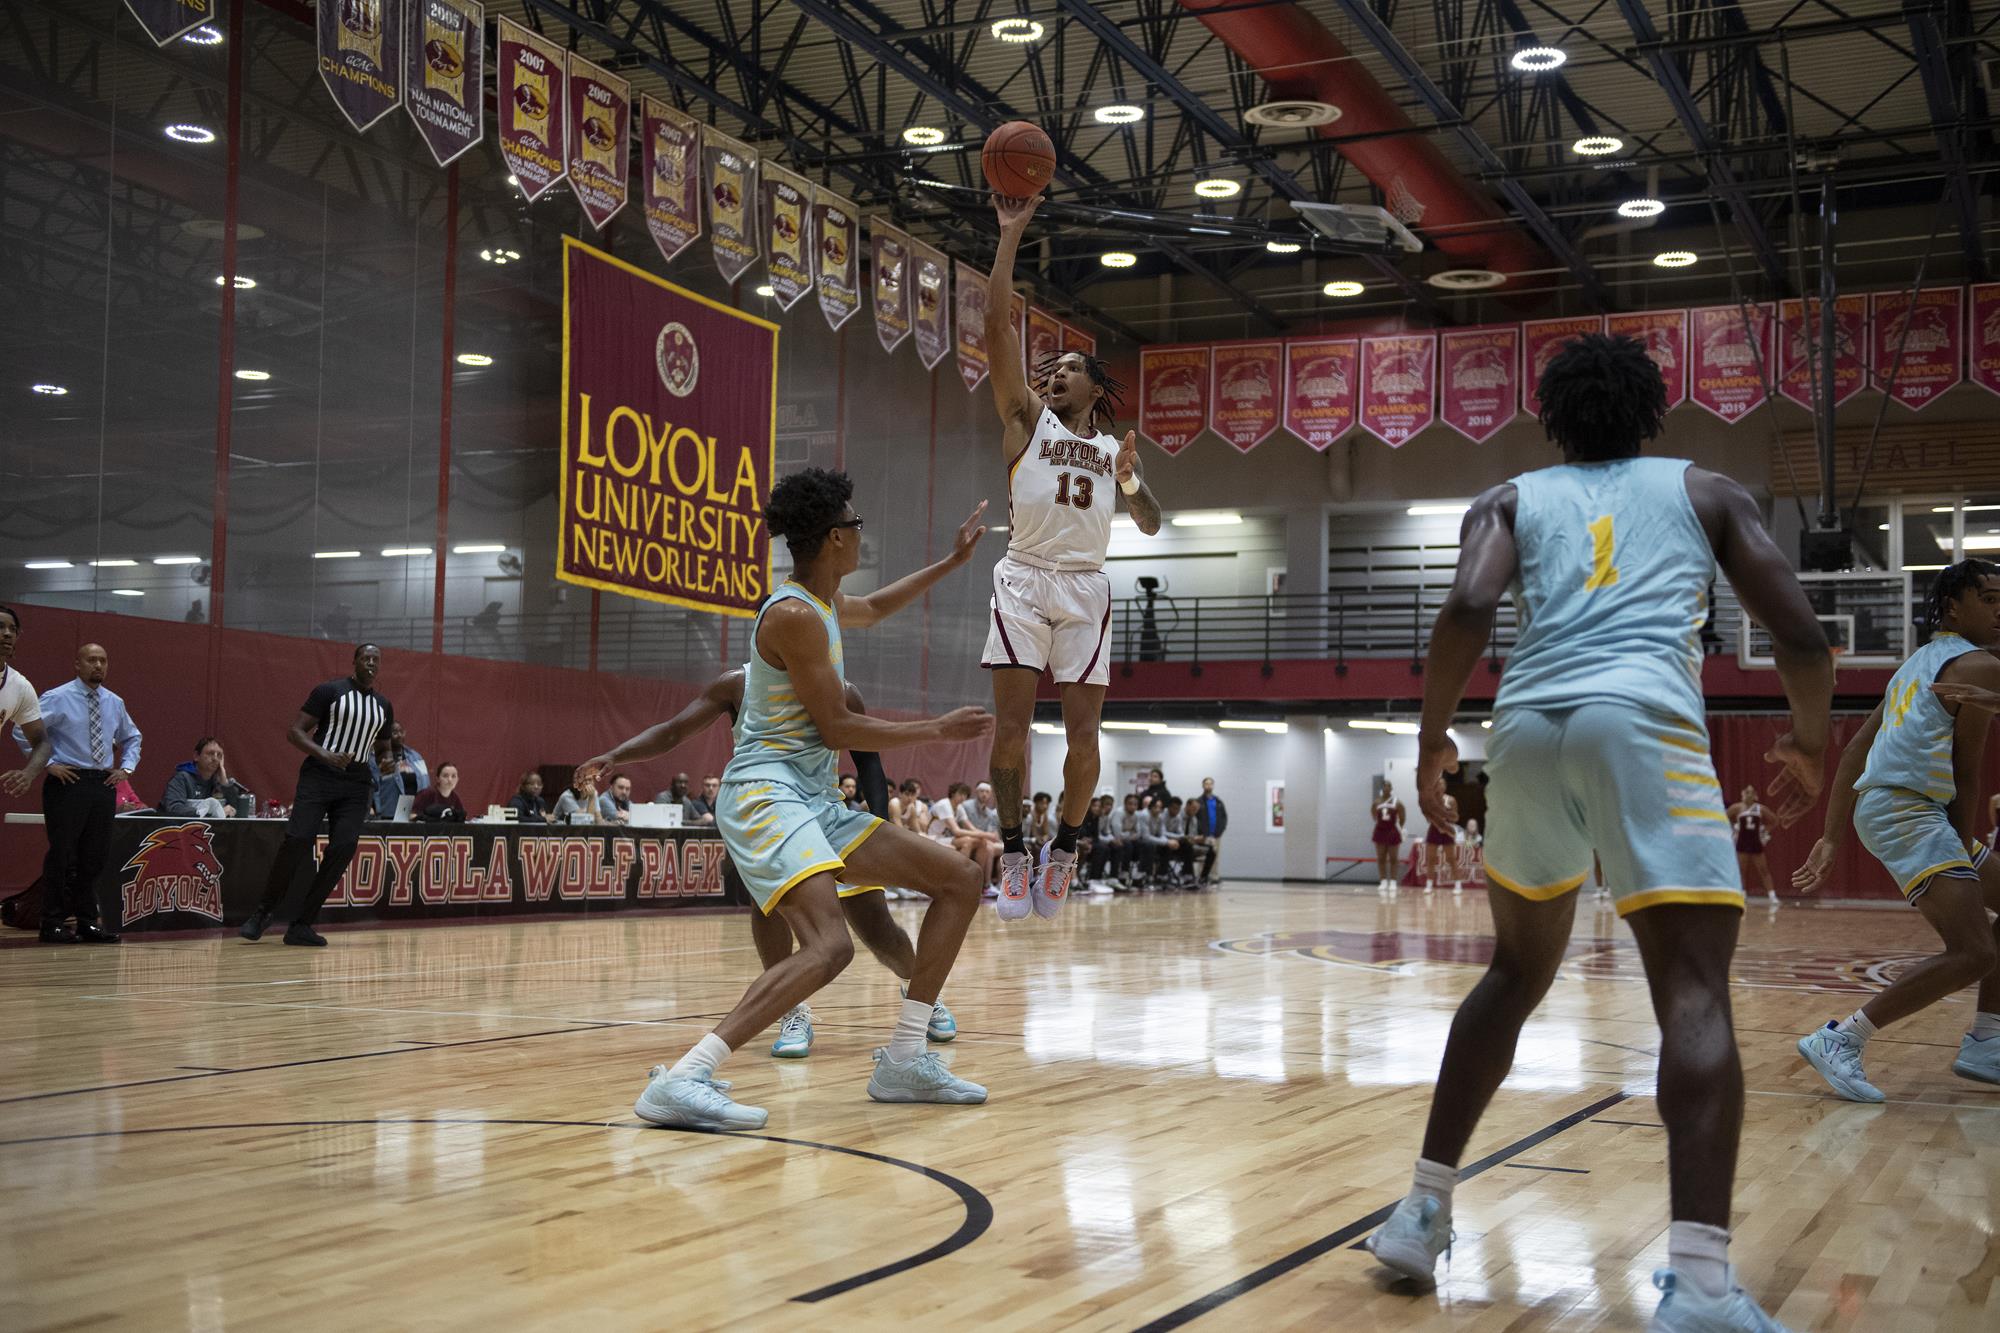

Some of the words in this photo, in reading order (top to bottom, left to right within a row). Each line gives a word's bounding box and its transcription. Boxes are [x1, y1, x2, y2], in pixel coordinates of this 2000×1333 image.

[430, 3, 459, 28] 2005
[519, 49, 545, 72] 2007
[320, 57, 395, 99] CHAMPIONS
[588, 84, 612, 105] 2007
[411, 88, 432, 107] NAIA
[432, 100, 475, 127] NATIONAL
[416, 104, 472, 139] TOURNAMENT
[501, 138, 561, 172] CHAMPIONS
[571, 167, 625, 200] CHAMPIONS
[1704, 309, 1761, 325] DANE
[1373, 340, 1424, 354] DANCE
[1699, 376, 1766, 390] CHAMPION
[1788, 367, 1857, 383] CHAONS
[1902, 387, 1931, 398] 2019
[1145, 410, 1164, 419] NAIA
[1165, 409, 1202, 418] NATIONAL
[1217, 408, 1274, 420] CHAMPIONS
[1292, 407, 1350, 418] CHAMPIONS
[1367, 404, 1427, 416] CHAMPIONS
[1719, 402, 1746, 414] 2019
[1467, 415, 1493, 427] 2018
[1160, 434, 1187, 446] 2017
[1233, 432, 1256, 443] 2017
[1308, 431, 1333, 441] 2018
[1383, 428, 1409, 439] 2018
[577, 393, 761, 511] LOYOLA
[1039, 439, 1113, 477] LOYOLA
[1049, 458, 1069, 466] NEW
[1069, 460, 1104, 477] ORLEANS
[1055, 472, 1094, 510] 13
[575, 469, 763, 558] UNIVERSITY
[574, 523, 645, 584] NEW
[643, 541, 762, 600] ORLEANS
[1584, 515, 1620, 592] 1
[518, 837, 636, 900] WOLF
[637, 838, 727, 898] PACK
[121, 874, 224, 927] LOYOLA
